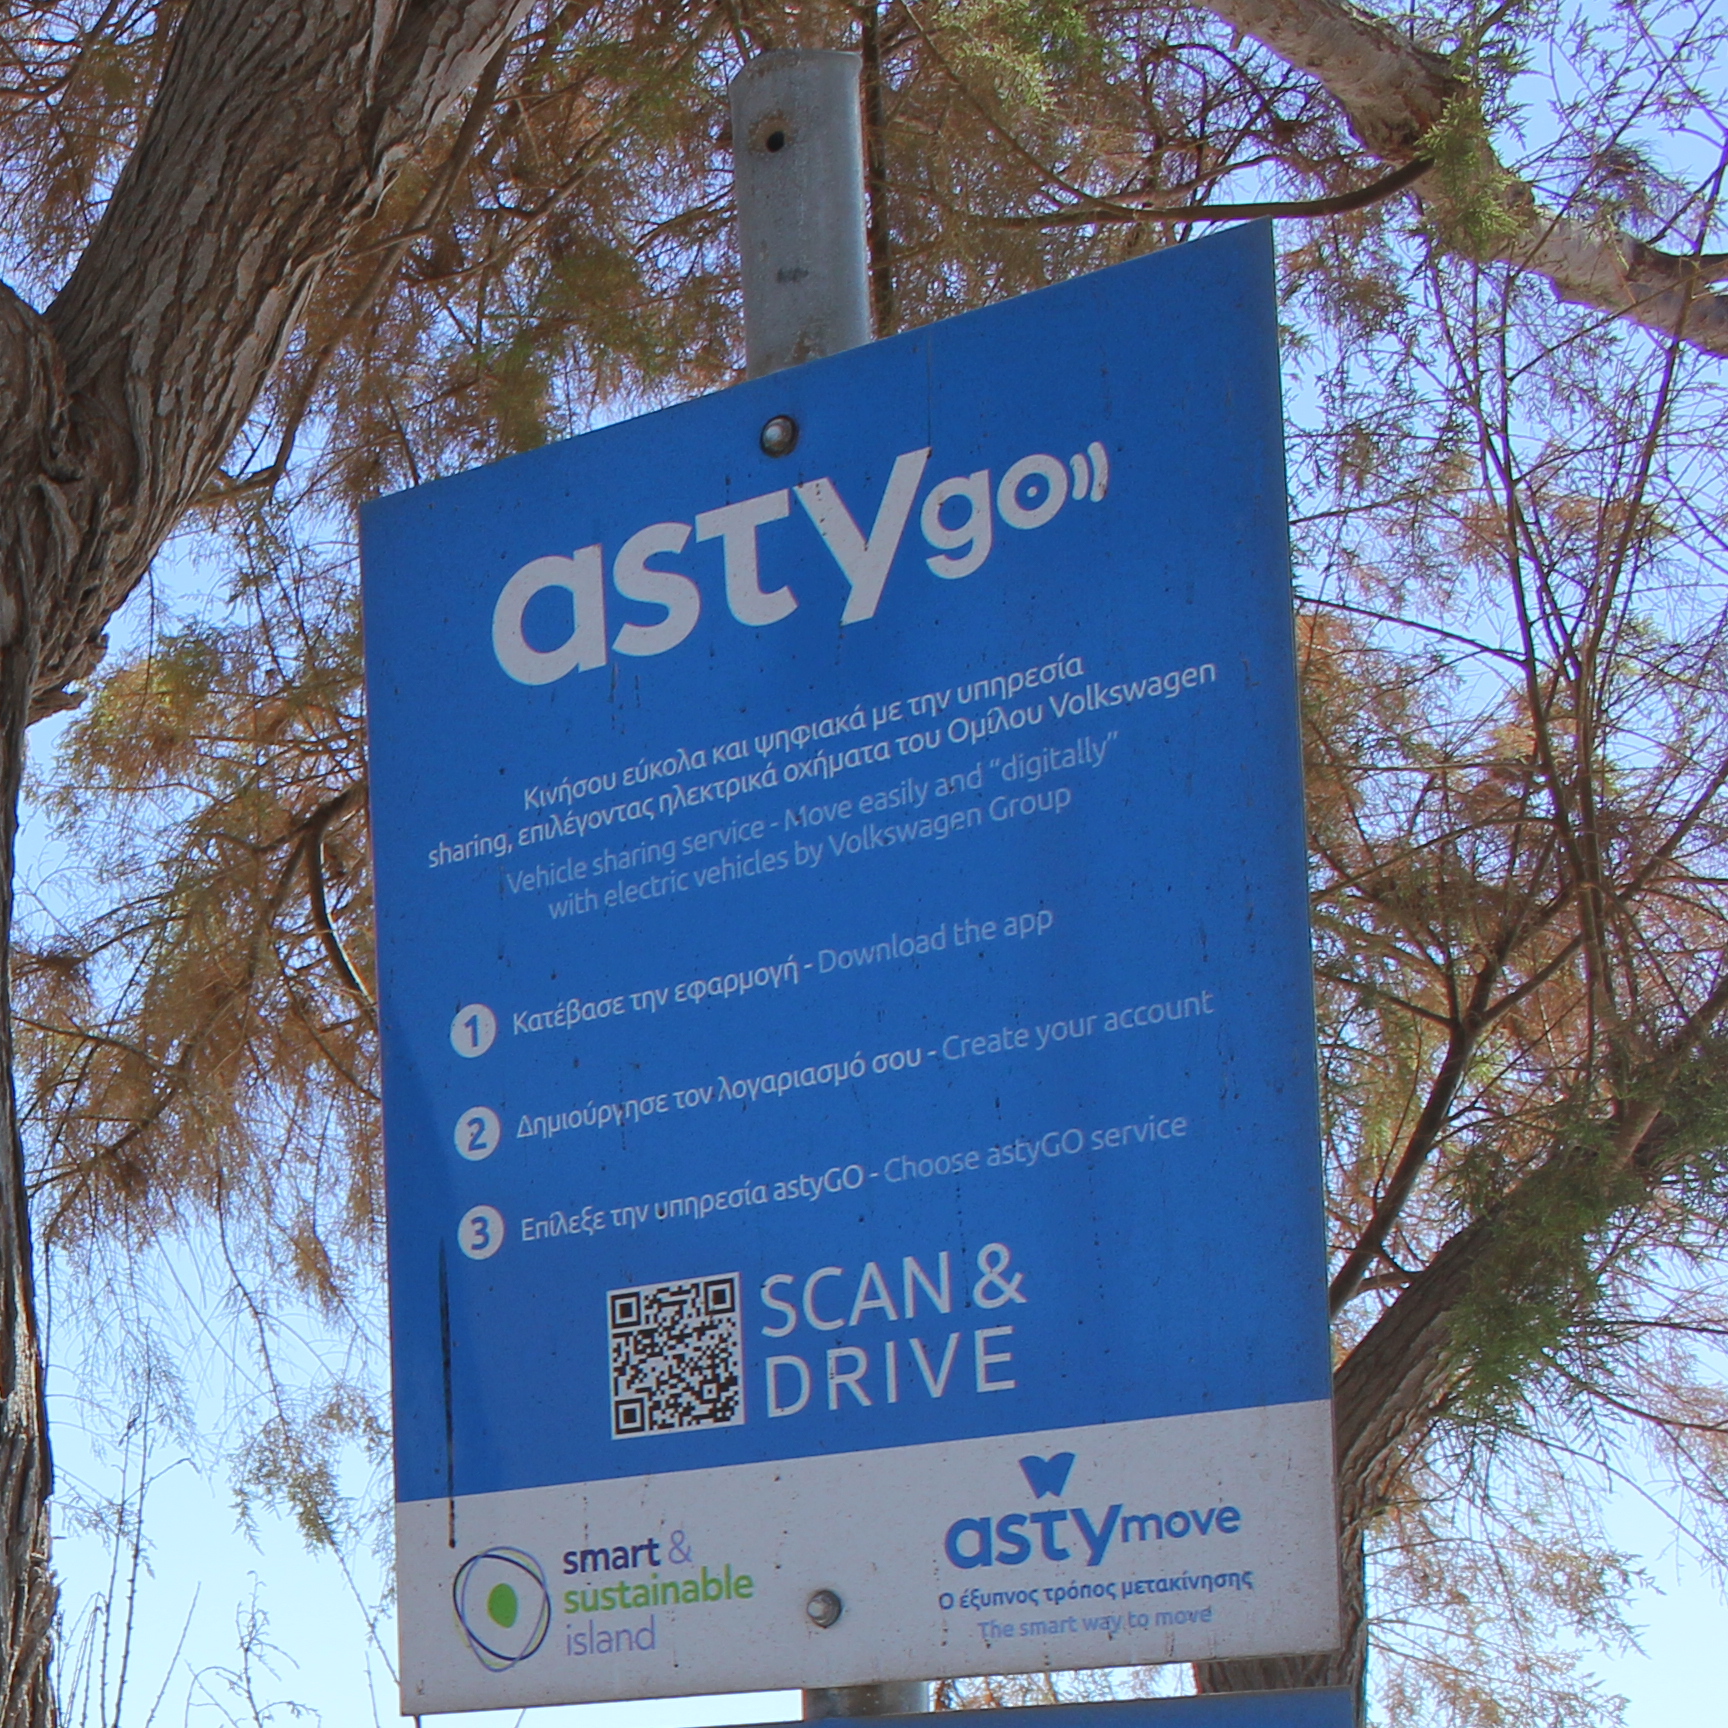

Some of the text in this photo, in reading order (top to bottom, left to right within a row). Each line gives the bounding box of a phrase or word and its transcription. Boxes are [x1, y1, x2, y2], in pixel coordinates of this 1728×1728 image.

[428, 662, 1219, 869] sharing, επιλέγοντας ηλεκτρικά οχήματα του Ομίλου Volkswagen
[524, 656, 1087, 811] Κινήσου εύκολα και ψηφιακά με την υπηρεσία
[506, 857, 589, 894] Vehicle
[592, 839, 677, 876] sharing
[682, 819, 766, 856] service
[785, 799, 854, 831] Move
[858, 777, 930, 814] easily
[935, 762, 984, 797] and
[548, 787, 1073, 919] with electric vehicles by Volkswagen Group
[463, 1013, 479, 1049] 1
[513, 995, 627, 1036] Κατέβασε
[628, 987, 670, 1014] την
[674, 953, 801, 1005] εφαρμογή
[818, 922, 947, 974] Download
[953, 918, 998, 946] the
[1004, 909, 1054, 939] app
[467, 1115, 487, 1152] 2
[516, 1093, 671, 1139] Δημιούργησε
[672, 1085, 715, 1110] τον
[717, 1050, 869, 1102] λογαριασμό
[871, 1047, 924, 1074] σου
[942, 1026, 1031, 1060] Create
[1035, 1014, 1098, 1051] your
[1104, 989, 1216, 1032] account
[470, 1214, 490, 1251] 3
[521, 1205, 608, 1242] Επίλεξε
[609, 1203, 651, 1230] την
[654, 1179, 771, 1220] υπηρεσία
[772, 1163, 866, 1202] astyGO
[884, 1150, 982, 1183] Choose
[986, 1128, 1086, 1167] astyGO
[1091, 1114, 1189, 1151] service
[760, 1241, 1030, 1338] SCAN &
[766, 1324, 1019, 1418] DRIVE
[563, 1529, 692, 1575] smart &
[564, 1564, 753, 1614] sustainable
[959, 1588, 1040, 1611] έξυπνος
[1042, 1580, 1118, 1606] τρόπος
[1121, 1570, 1254, 1600] μετακίνησης
[567, 1614, 655, 1656] island
[978, 1606, 1213, 1639] The smart way to move
